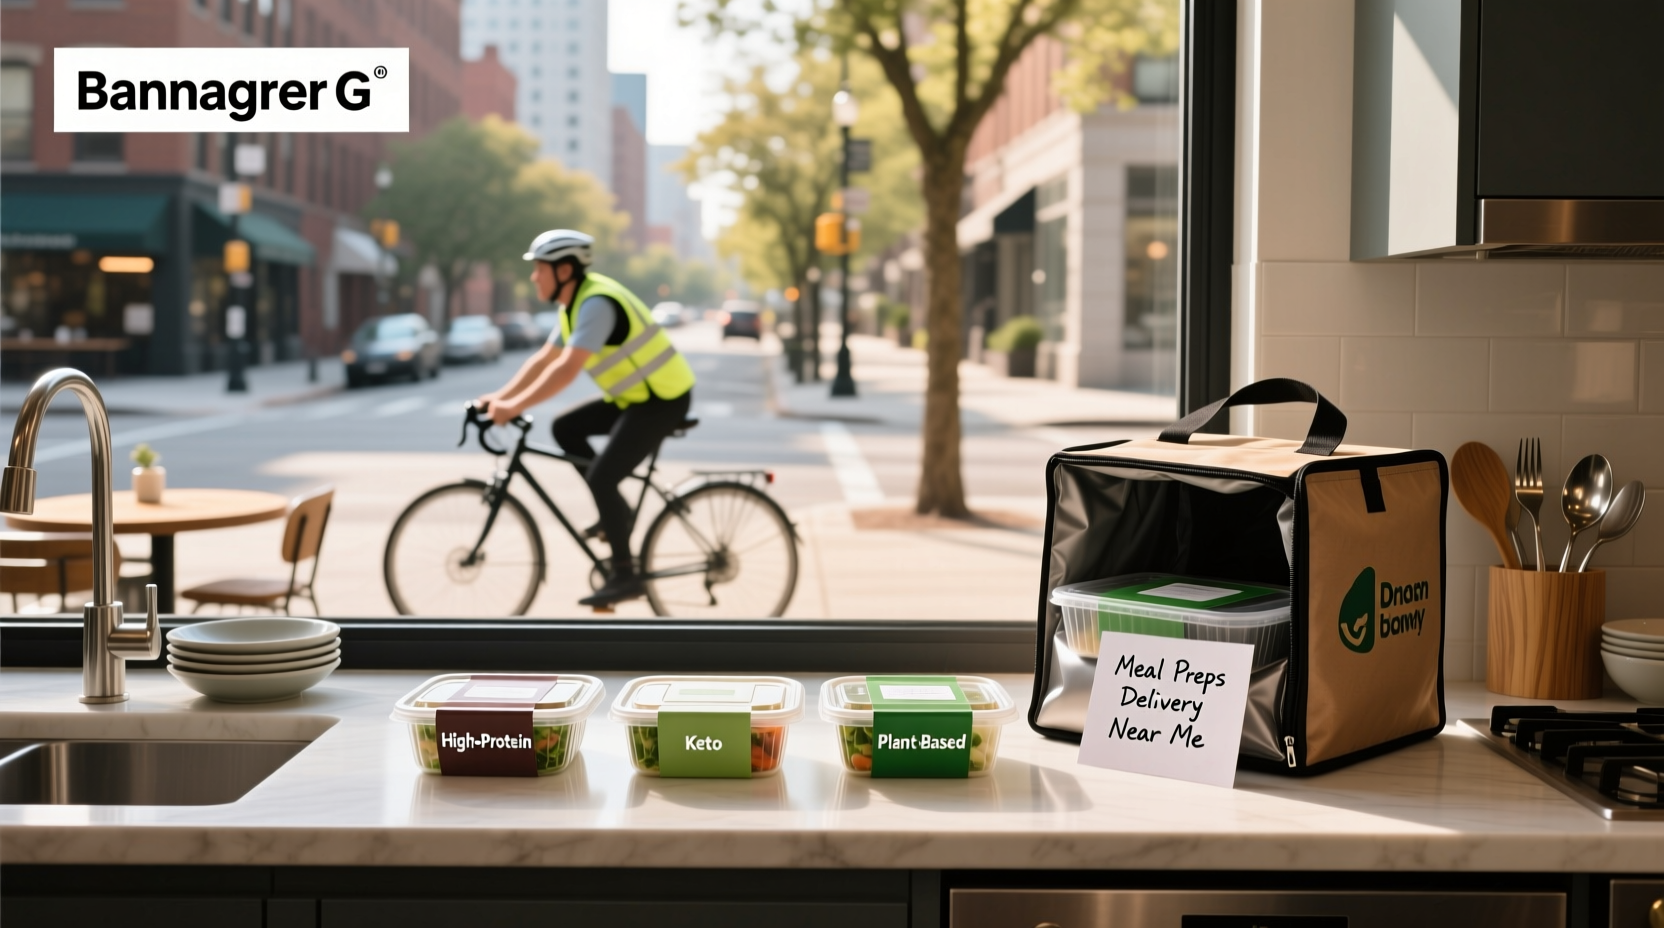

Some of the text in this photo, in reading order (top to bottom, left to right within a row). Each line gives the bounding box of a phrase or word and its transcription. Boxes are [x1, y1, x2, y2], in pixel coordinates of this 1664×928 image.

[1114, 654, 1226, 695] Meal Preps
[1120, 685, 1204, 723] Delivery
[441, 732, 532, 753] High-Protein
[685, 735, 723, 751] Keto
[1108, 717, 1205, 749] Near Me
